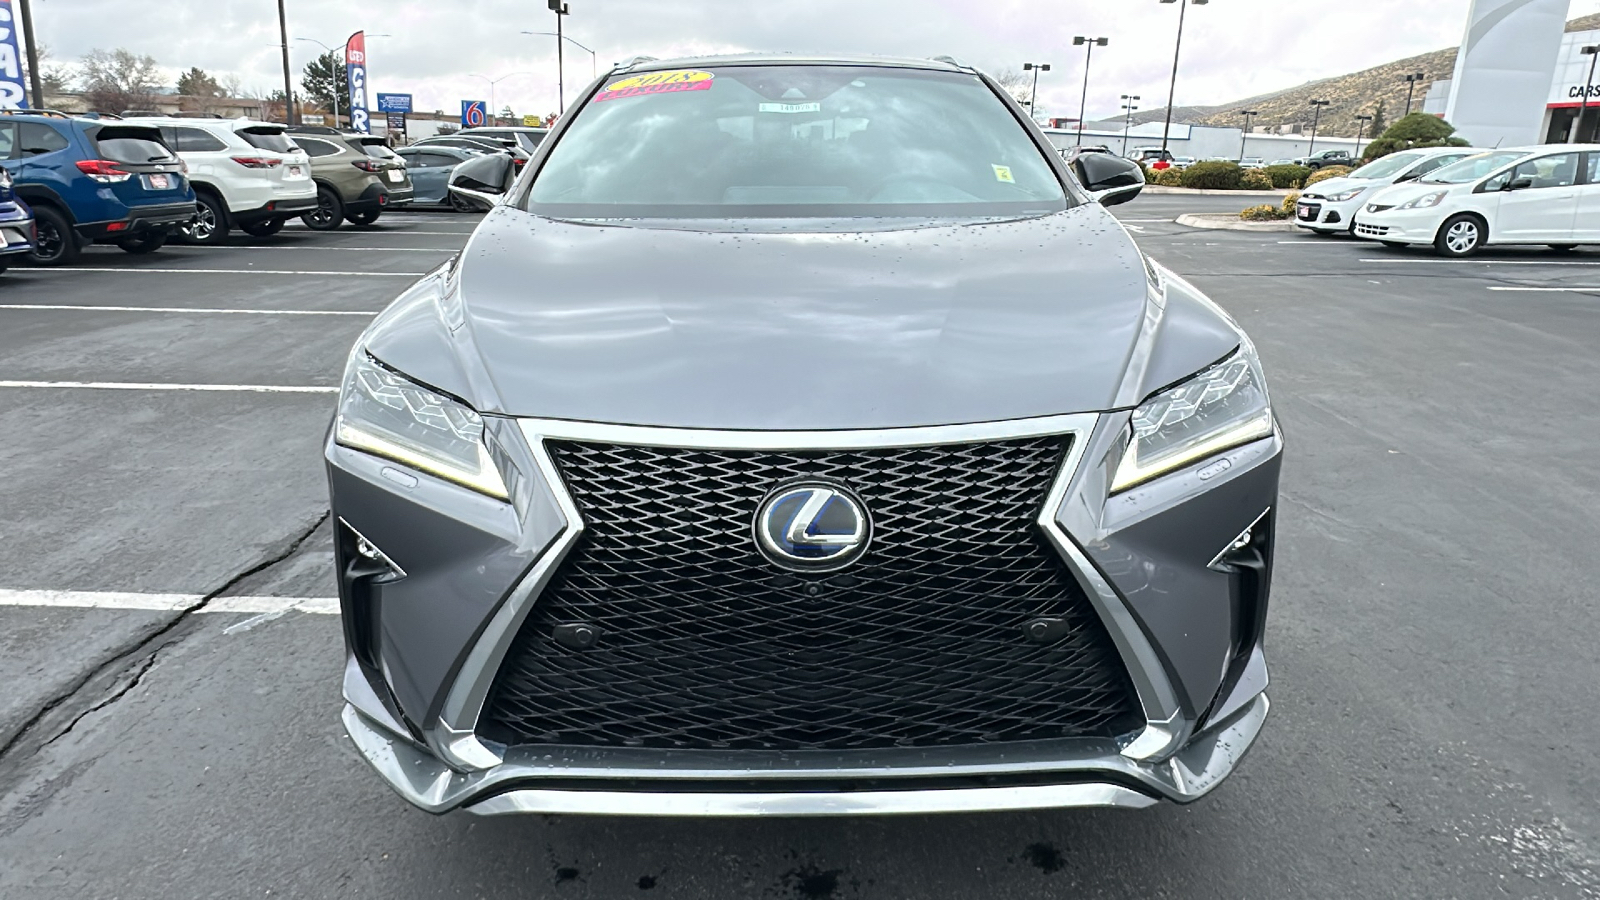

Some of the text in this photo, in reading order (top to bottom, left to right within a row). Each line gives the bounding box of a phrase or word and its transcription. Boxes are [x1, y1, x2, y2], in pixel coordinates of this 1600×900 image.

[628, 71, 697, 87] 2018
[602, 81, 702, 99] LUXURY
[466, 101, 484, 126] 6
